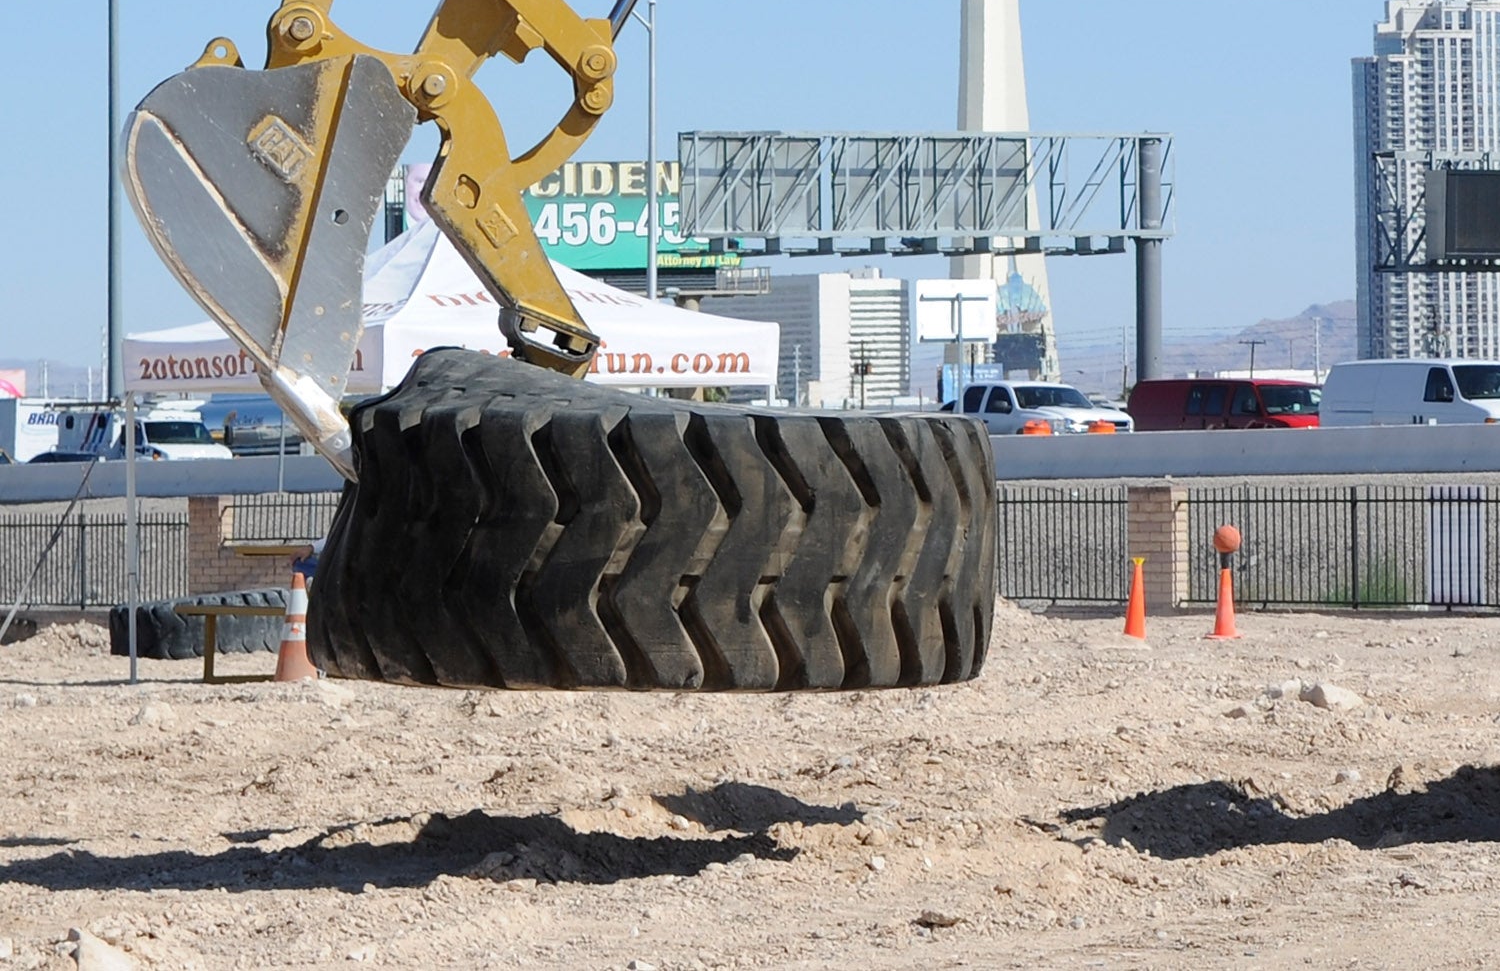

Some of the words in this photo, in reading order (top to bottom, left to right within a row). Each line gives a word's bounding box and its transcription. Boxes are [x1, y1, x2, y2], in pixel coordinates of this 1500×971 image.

[521, 161, 680, 198] CIDEN
[534, 202, 709, 246] 456-45
[656, 254, 703, 268] Attorney
[706, 255, 717, 266] at
[719, 254, 742, 267] Law
[566, 289, 643, 308] HIS
[139, 348, 258, 380] 20tonsof
